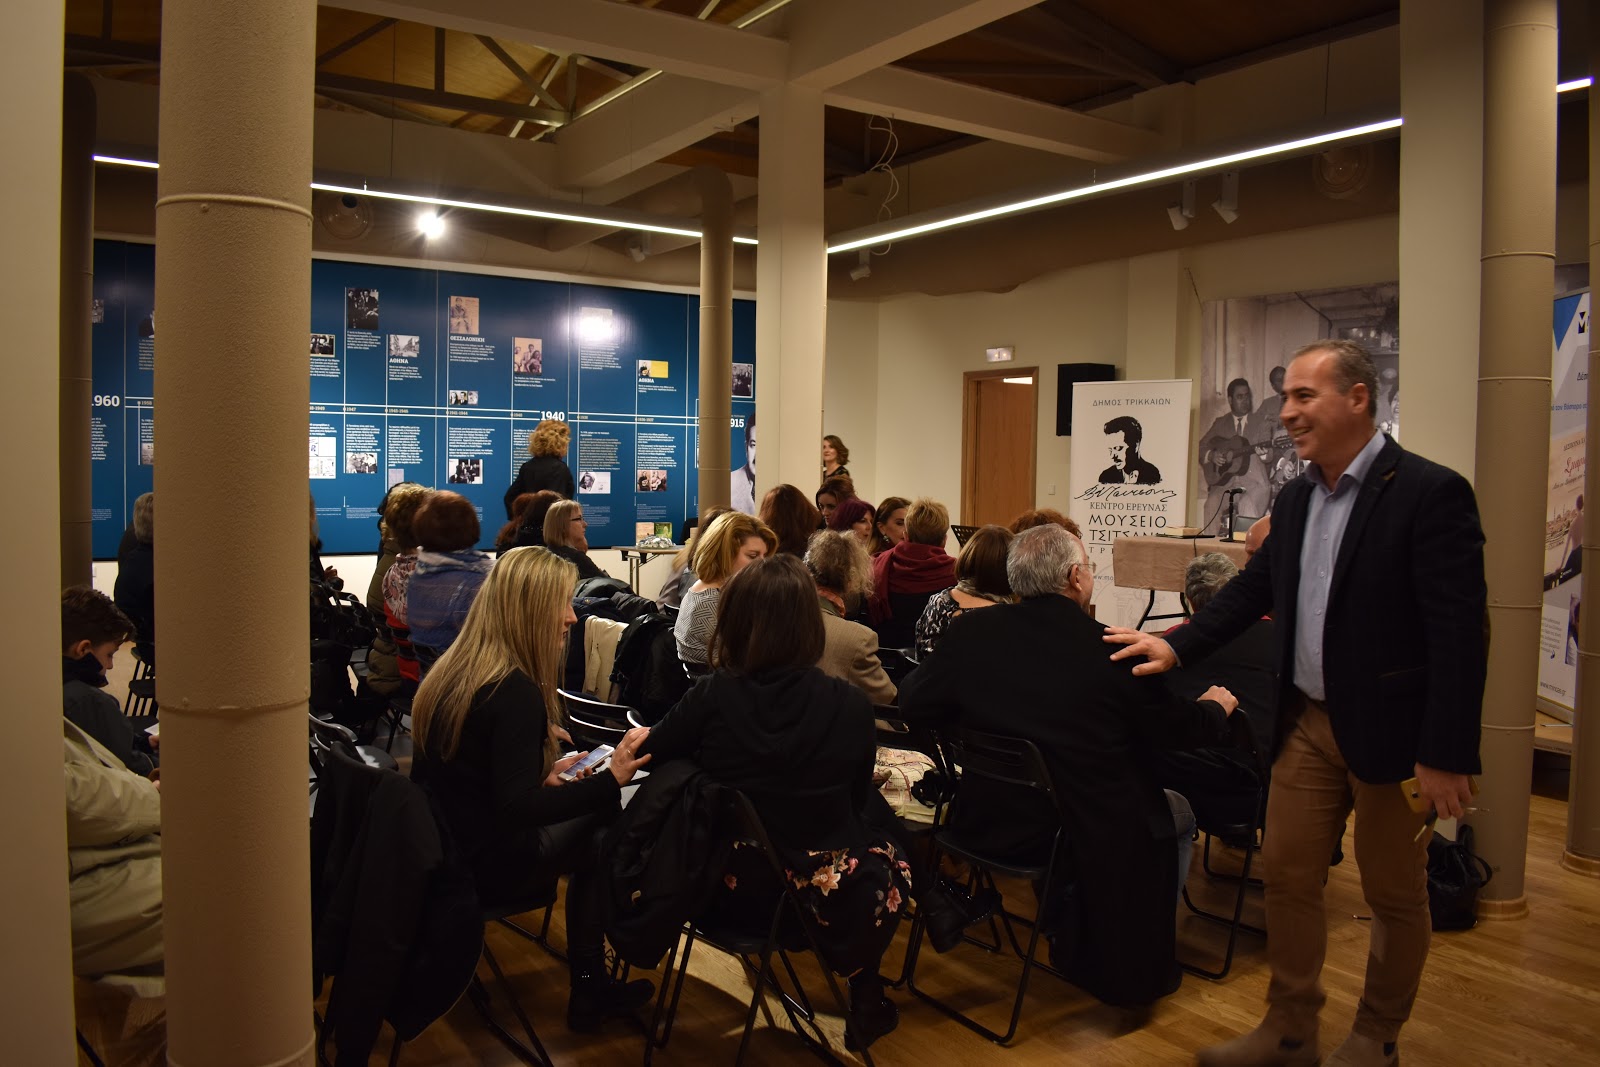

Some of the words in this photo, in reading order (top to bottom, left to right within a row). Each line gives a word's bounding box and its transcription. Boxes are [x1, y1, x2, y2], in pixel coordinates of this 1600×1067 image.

[91, 395, 120, 407] 960
[1125, 398, 1171, 406] ΤΡΙΚΚΑΙΩΝ
[540, 410, 565, 421] 1940
[730, 418, 745, 428] 915
[1090, 502, 1124, 510] ΚΕΝΤΡΟ
[1126, 503, 1168, 512] ΕΡΕΥΝΑΣ
[1088, 514, 1167, 528] ΜΟΥΣΕΙΟ
